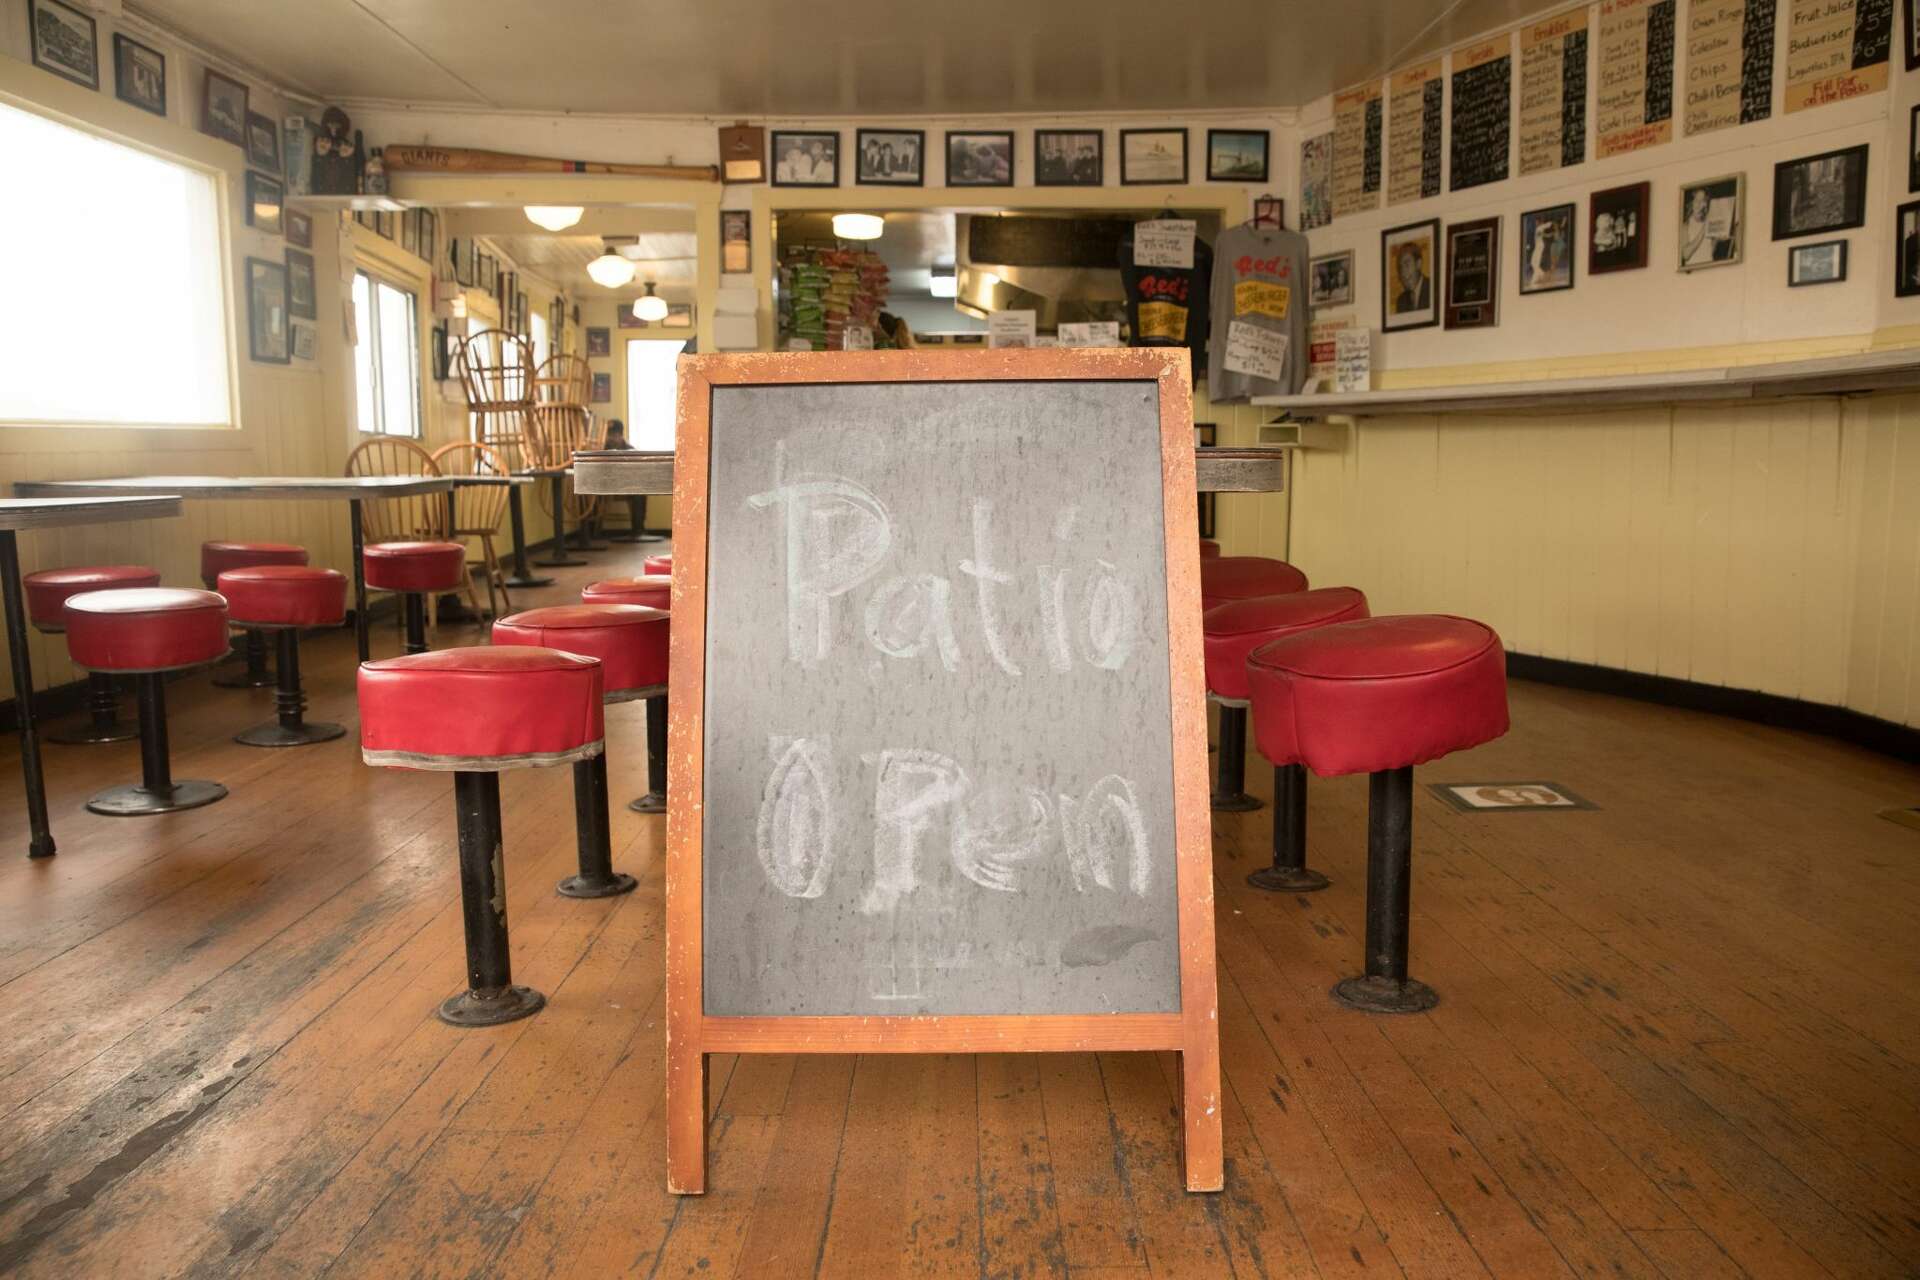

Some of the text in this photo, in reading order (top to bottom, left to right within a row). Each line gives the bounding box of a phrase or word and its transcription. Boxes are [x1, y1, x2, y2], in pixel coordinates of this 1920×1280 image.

[1789, 27, 1852, 54] Budweiser
[1690, 64, 1727, 81] Chips
[401, 150, 449, 167] GIANTS
[747, 464, 1138, 676] Patio
